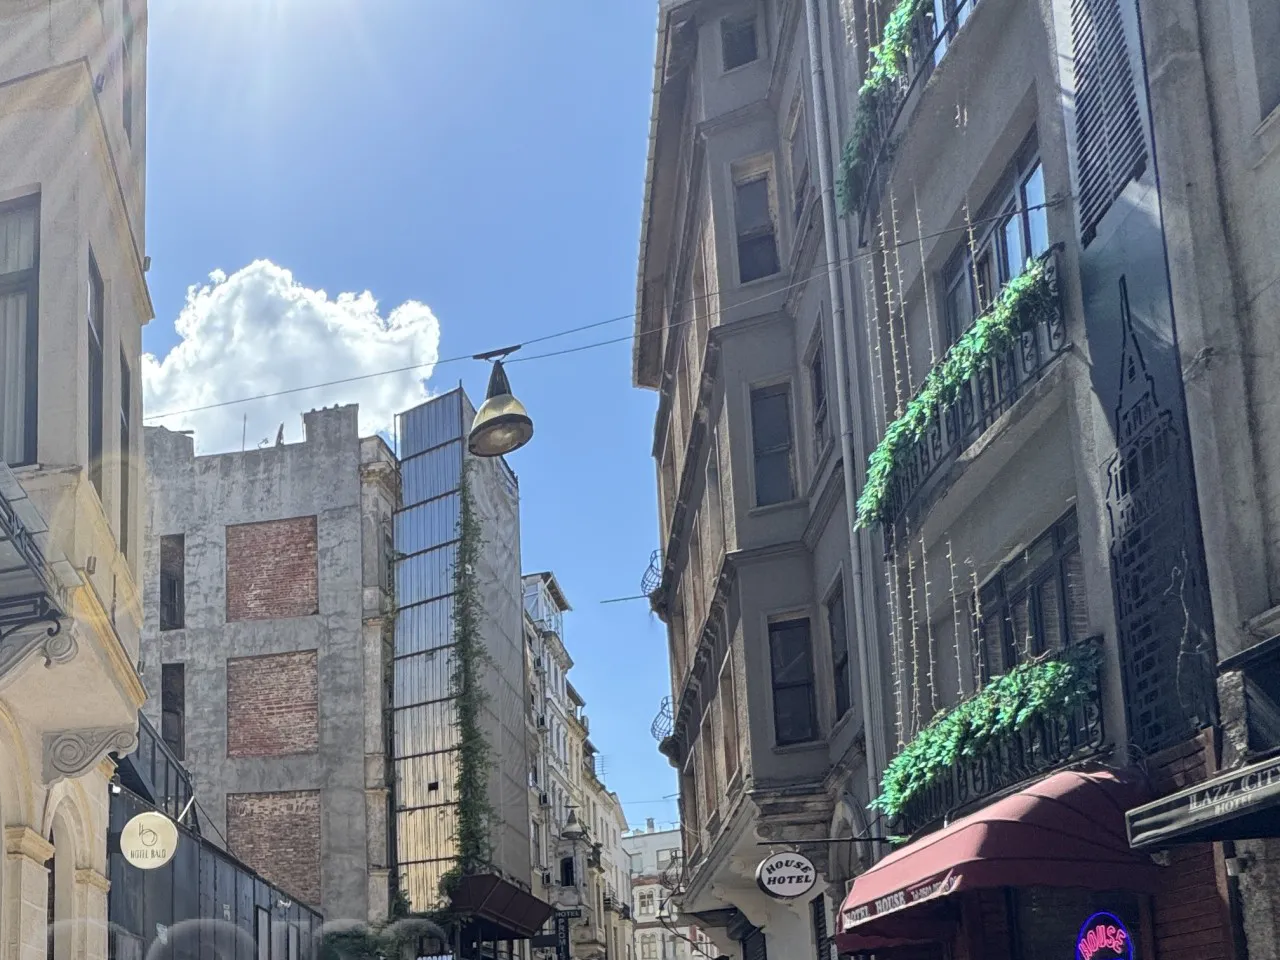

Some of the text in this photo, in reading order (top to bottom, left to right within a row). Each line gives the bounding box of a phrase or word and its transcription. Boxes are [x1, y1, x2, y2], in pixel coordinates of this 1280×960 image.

[130, 849, 148, 859] HOTEL
[765, 859, 813, 875] HOUSE
[766, 874, 813, 886] HOTEL
[875, 890, 906, 914] HOUSE
